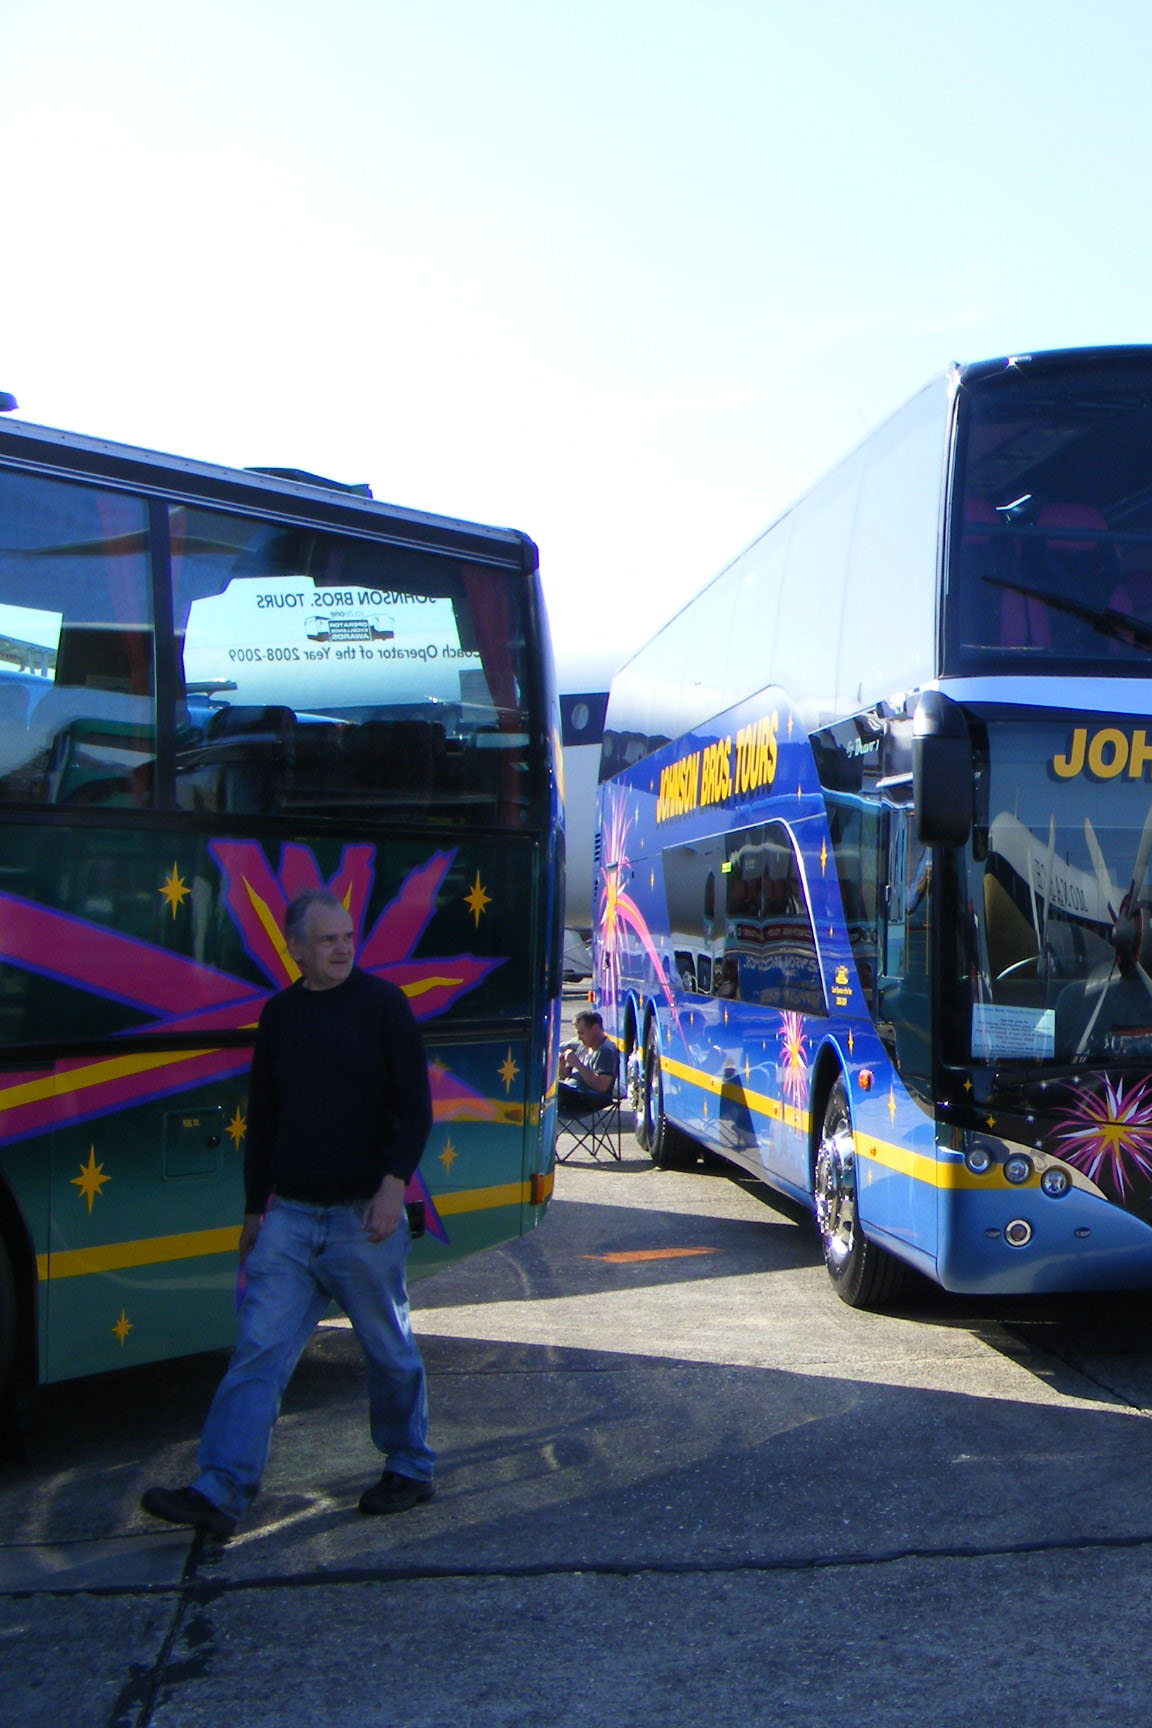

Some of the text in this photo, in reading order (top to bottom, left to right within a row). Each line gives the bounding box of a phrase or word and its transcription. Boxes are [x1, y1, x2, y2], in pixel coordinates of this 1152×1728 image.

[656, 709, 779, 824] JOHNSON BROS. TOURS
